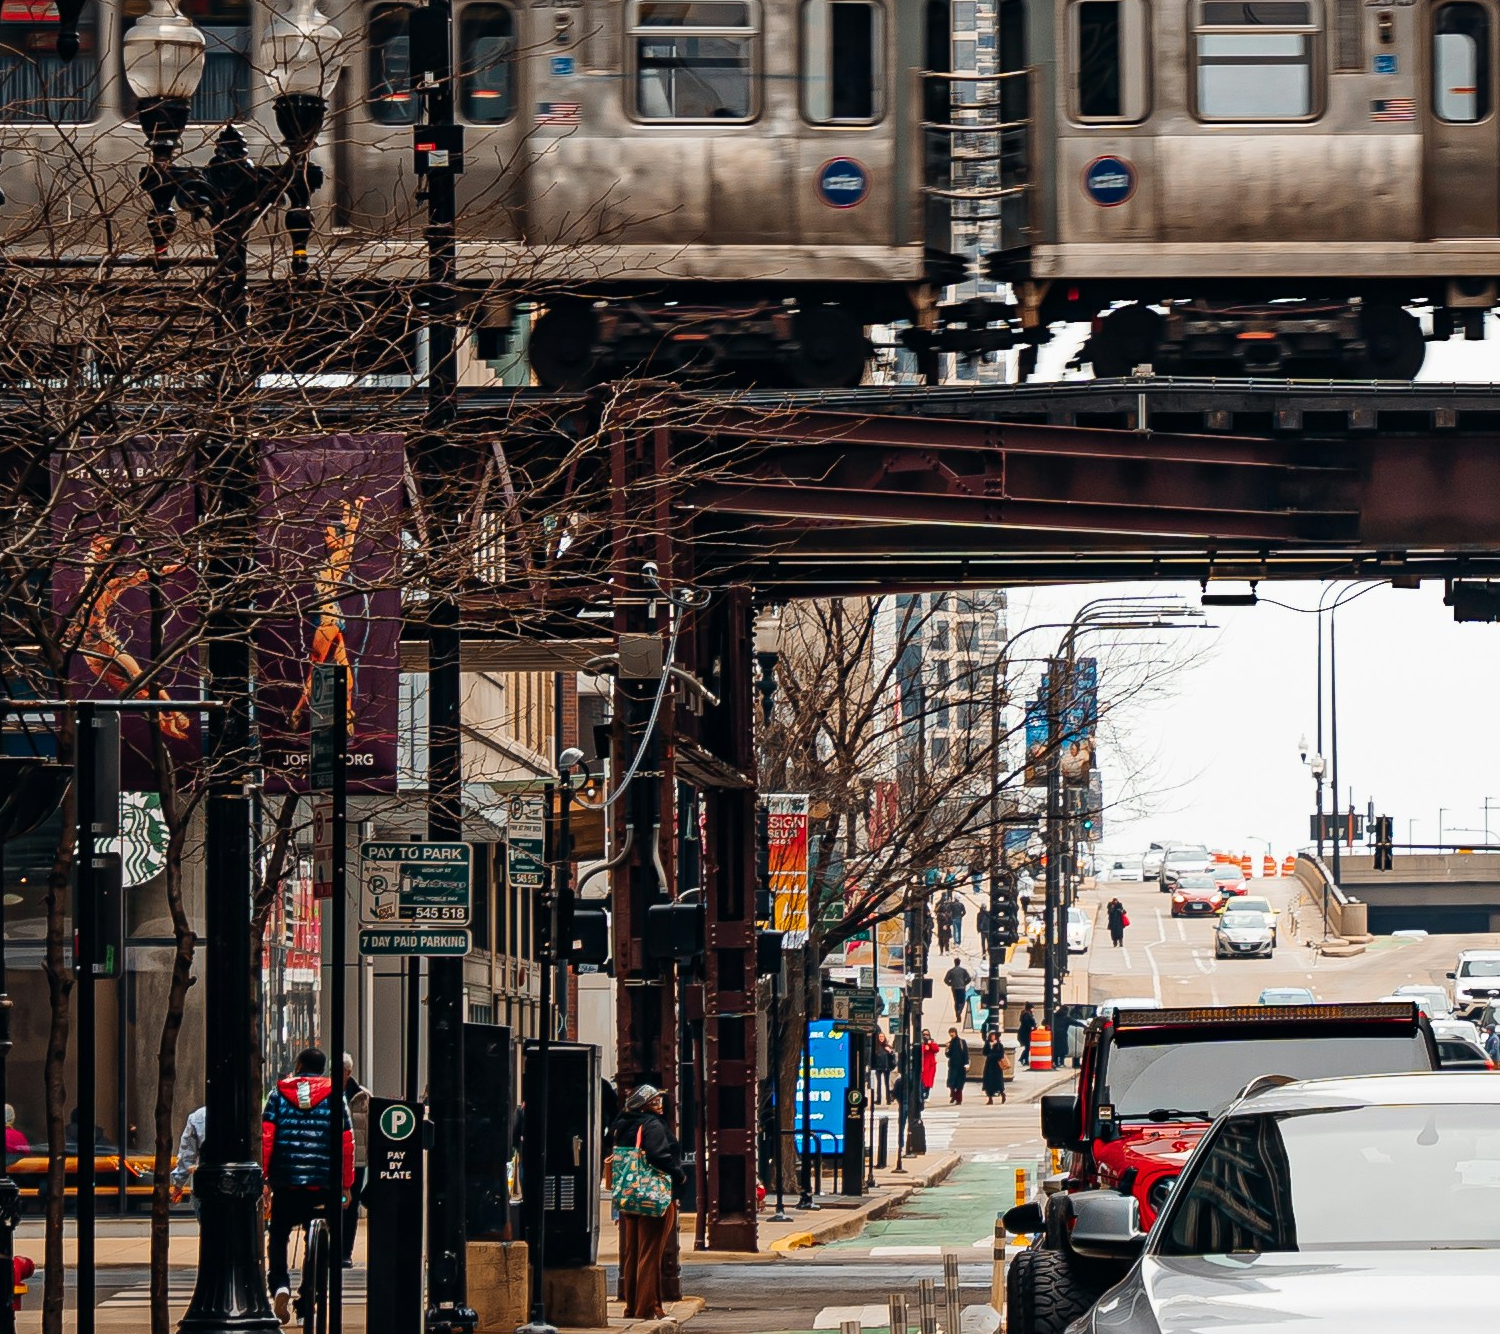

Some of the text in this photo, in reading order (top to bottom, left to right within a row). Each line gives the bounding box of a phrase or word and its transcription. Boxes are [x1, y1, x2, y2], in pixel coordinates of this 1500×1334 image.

[368, 847, 462, 859] PAY TO PARK
[416, 908, 438, 918] 545
[442, 908, 465, 918] 518
[362, 936, 466, 947] 7 DAY PAID PARKING
[391, 1110, 407, 1134] P
[387, 1151, 406, 1159] PAY
[389, 1161, 403, 1170] BY
[380, 1171, 412, 1180] PLATE
